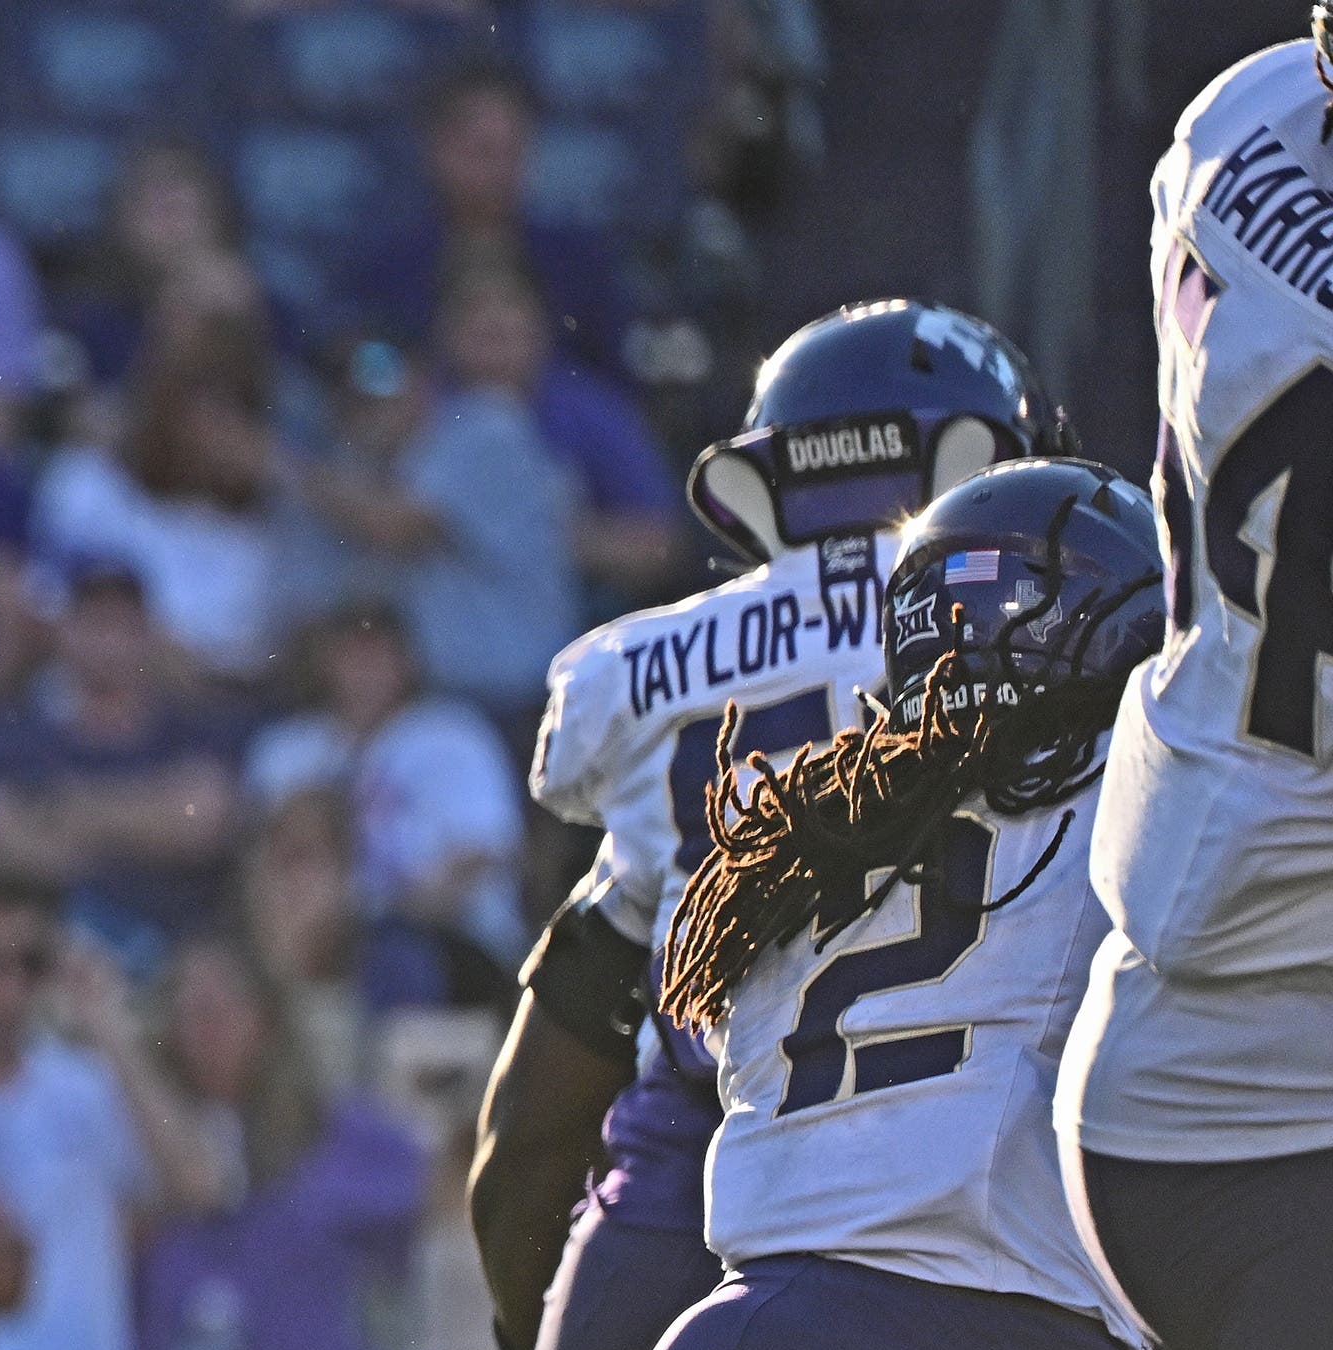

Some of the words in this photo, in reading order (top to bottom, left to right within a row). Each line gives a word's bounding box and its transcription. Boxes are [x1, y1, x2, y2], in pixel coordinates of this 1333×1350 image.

[787, 422, 904, 474] DOUGLAS
[623, 578, 884, 717] TAYLOR-W
[772, 808, 1000, 1118] 2
